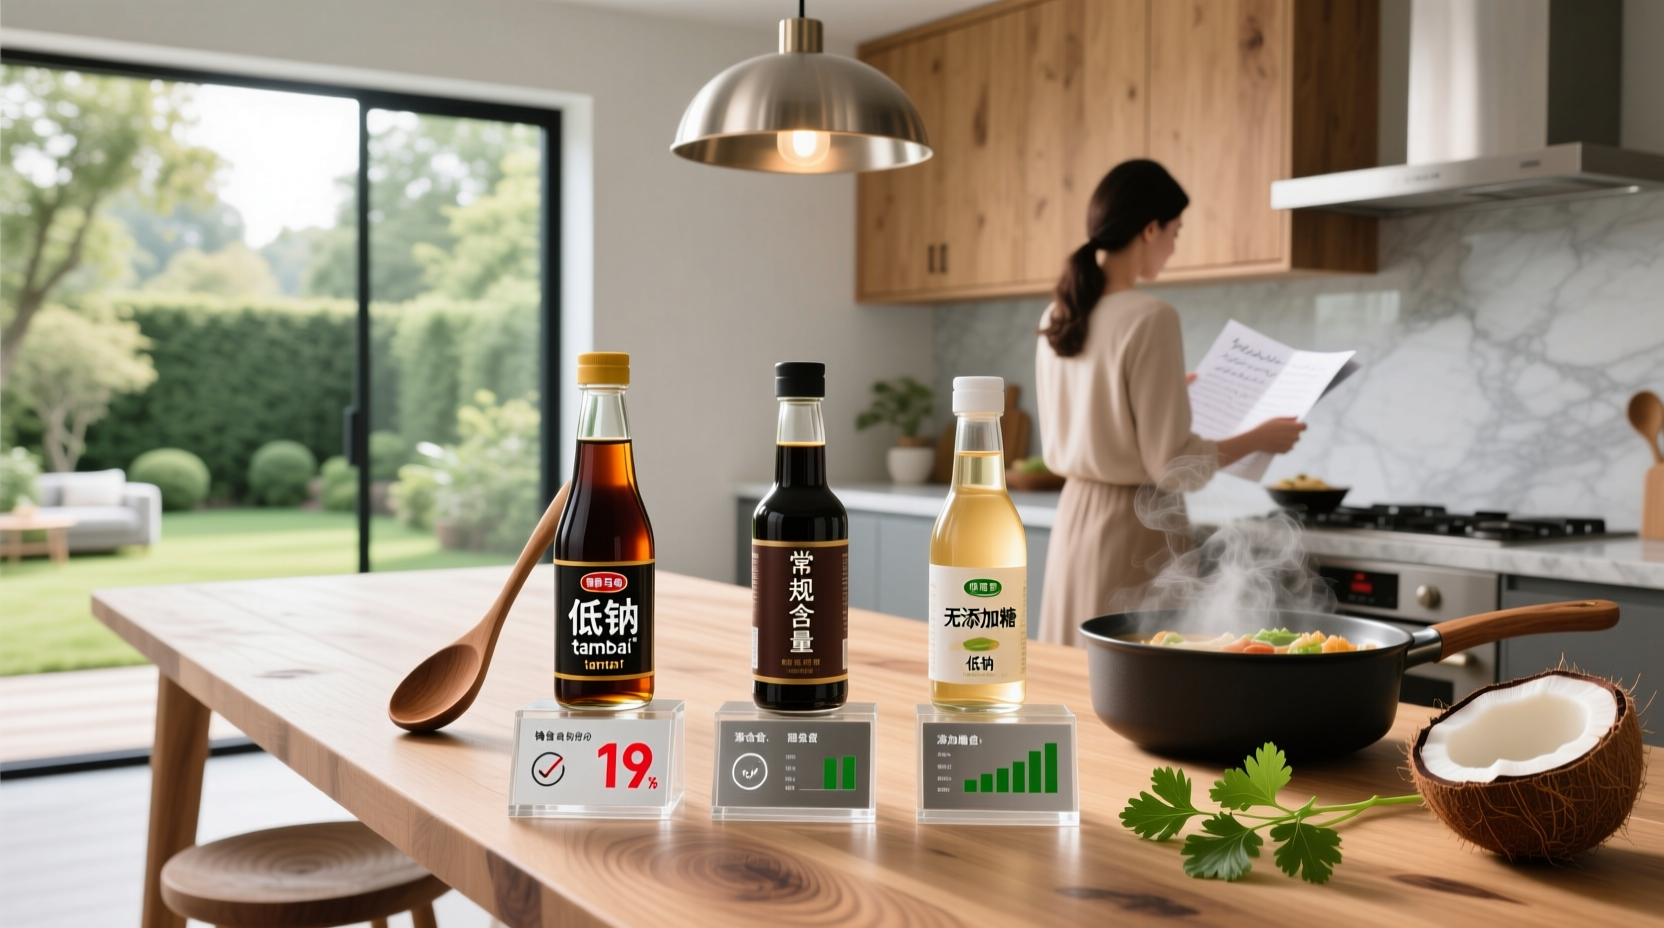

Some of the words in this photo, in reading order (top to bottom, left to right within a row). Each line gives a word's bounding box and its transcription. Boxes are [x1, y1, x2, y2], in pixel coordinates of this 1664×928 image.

[568, 598, 638, 636] 低钠
[789, 550, 814, 653] 常规含量
[944, 607, 1016, 629] 无添加糖
